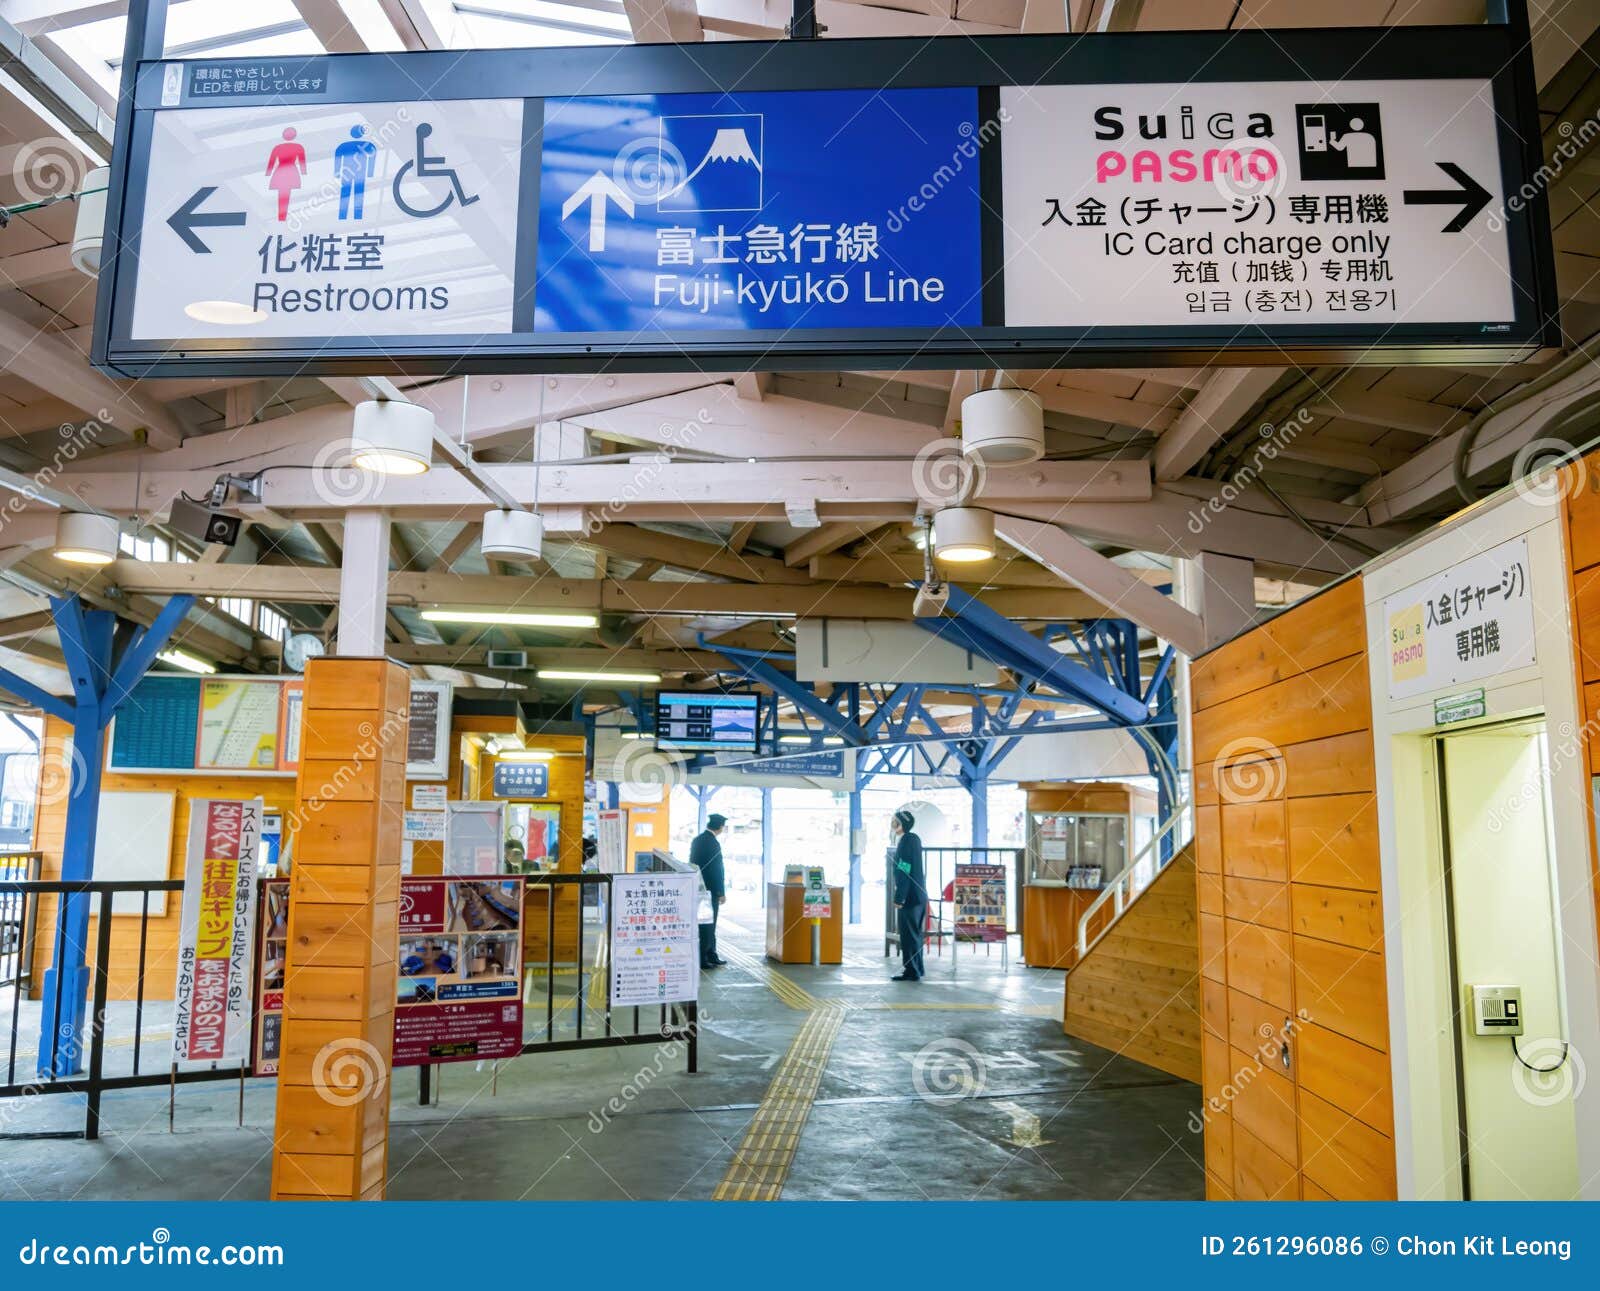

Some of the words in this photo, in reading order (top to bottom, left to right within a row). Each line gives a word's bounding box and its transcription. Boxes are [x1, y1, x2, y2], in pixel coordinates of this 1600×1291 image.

[193, 78, 323, 94] LEDを使用しています
[195, 66, 285, 80] 環境にやさしい
[1093, 104, 1276, 142] Suica
[1095, 148, 1279, 184] PASMO
[257, 232, 386, 275] 化粧室
[655, 222, 880, 266] 富士急行線
[1104, 233, 1134, 256] IC
[1145, 232, 1214, 256] Card
[1223, 231, 1322, 260] charge
[1332, 229, 1391, 259] only
[252, 281, 450, 313] Restrooms
[652, 272, 849, 314] Fuji-kyūkō
[863, 271, 945, 303] Line
[1186, 291, 1233, 313] 입금
[1324, 288, 1398, 312] 전용기
[1455, 618, 1501, 662] 専用機
[175, 947, 195, 1058] おでかけください。
